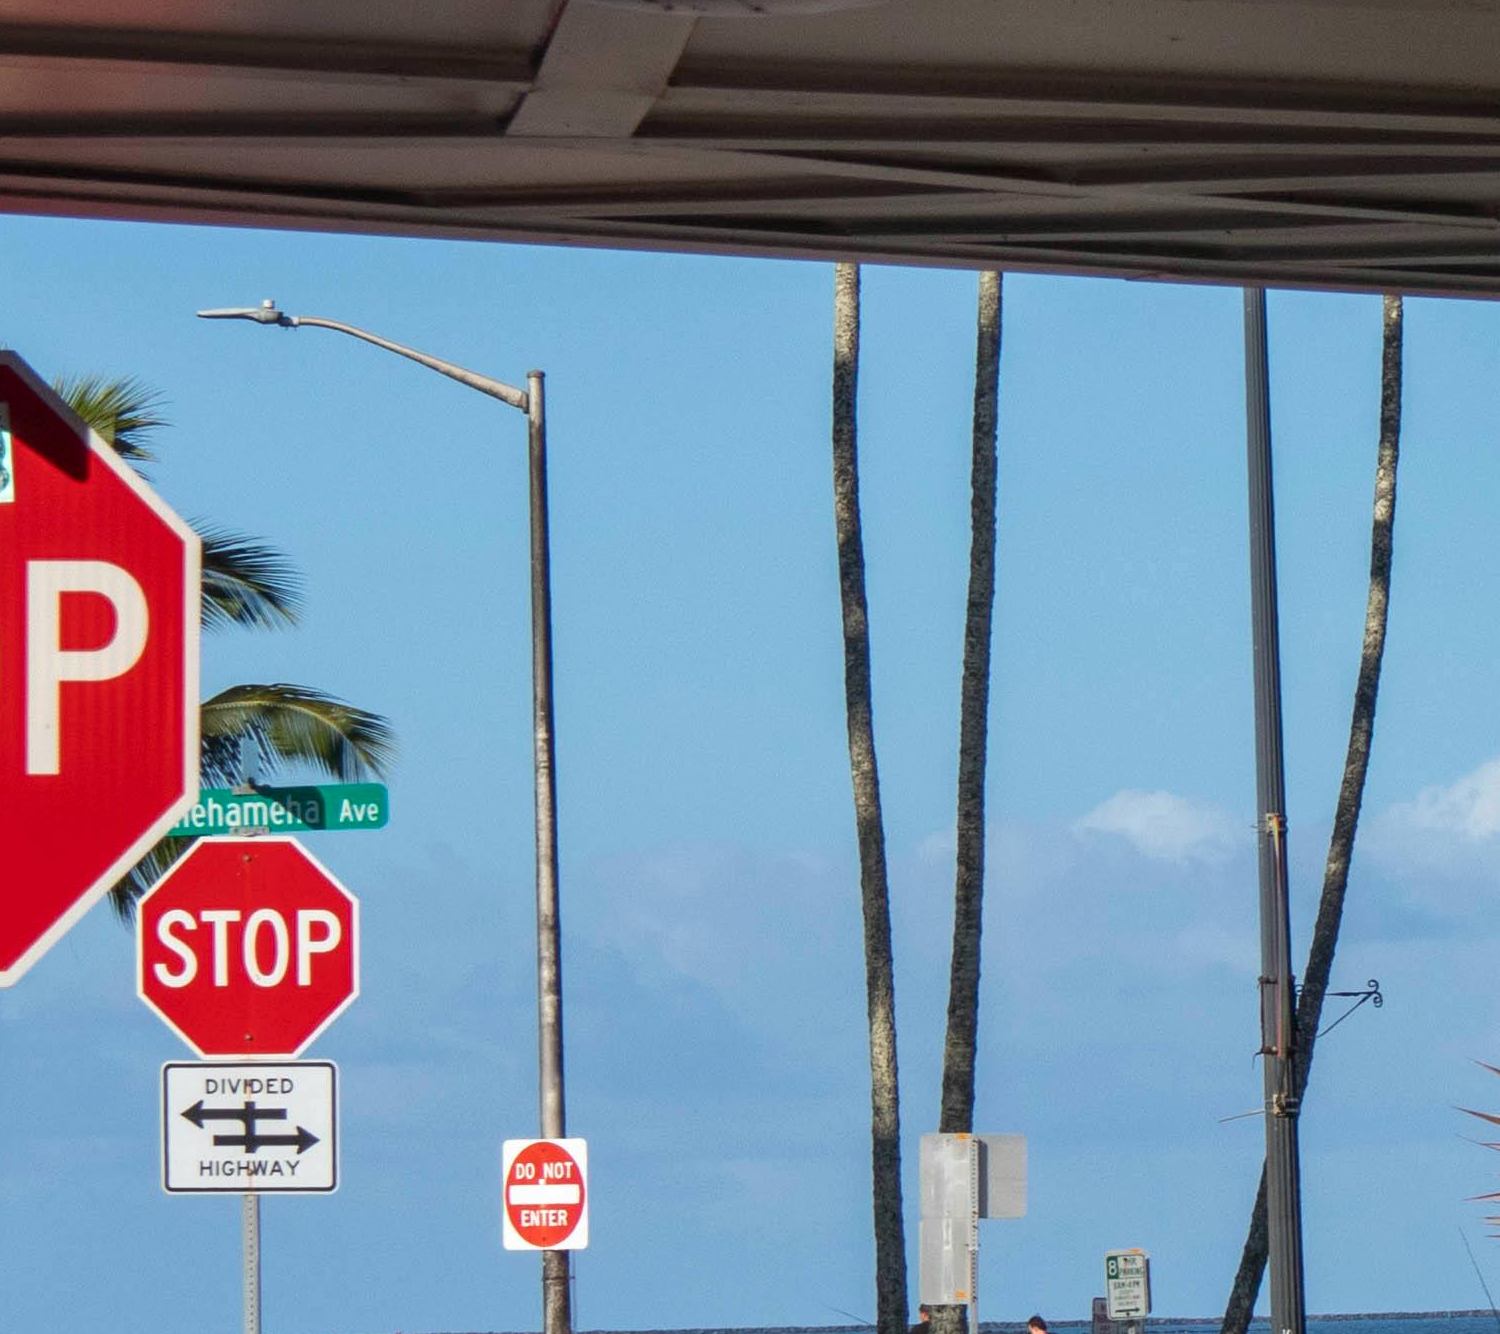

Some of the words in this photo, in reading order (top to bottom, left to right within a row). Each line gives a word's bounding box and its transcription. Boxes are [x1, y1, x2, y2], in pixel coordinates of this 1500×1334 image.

[339, 798, 380, 824] Ave
[153, 908, 342, 988] STOP
[204, 1077, 295, 1096] DIVIDED
[198, 1159, 301, 1178] HIGHWAY
[515, 1162, 539, 1180] DO
[542, 1161, 573, 1180] NOT
[520, 1210, 568, 1227] ENTER
